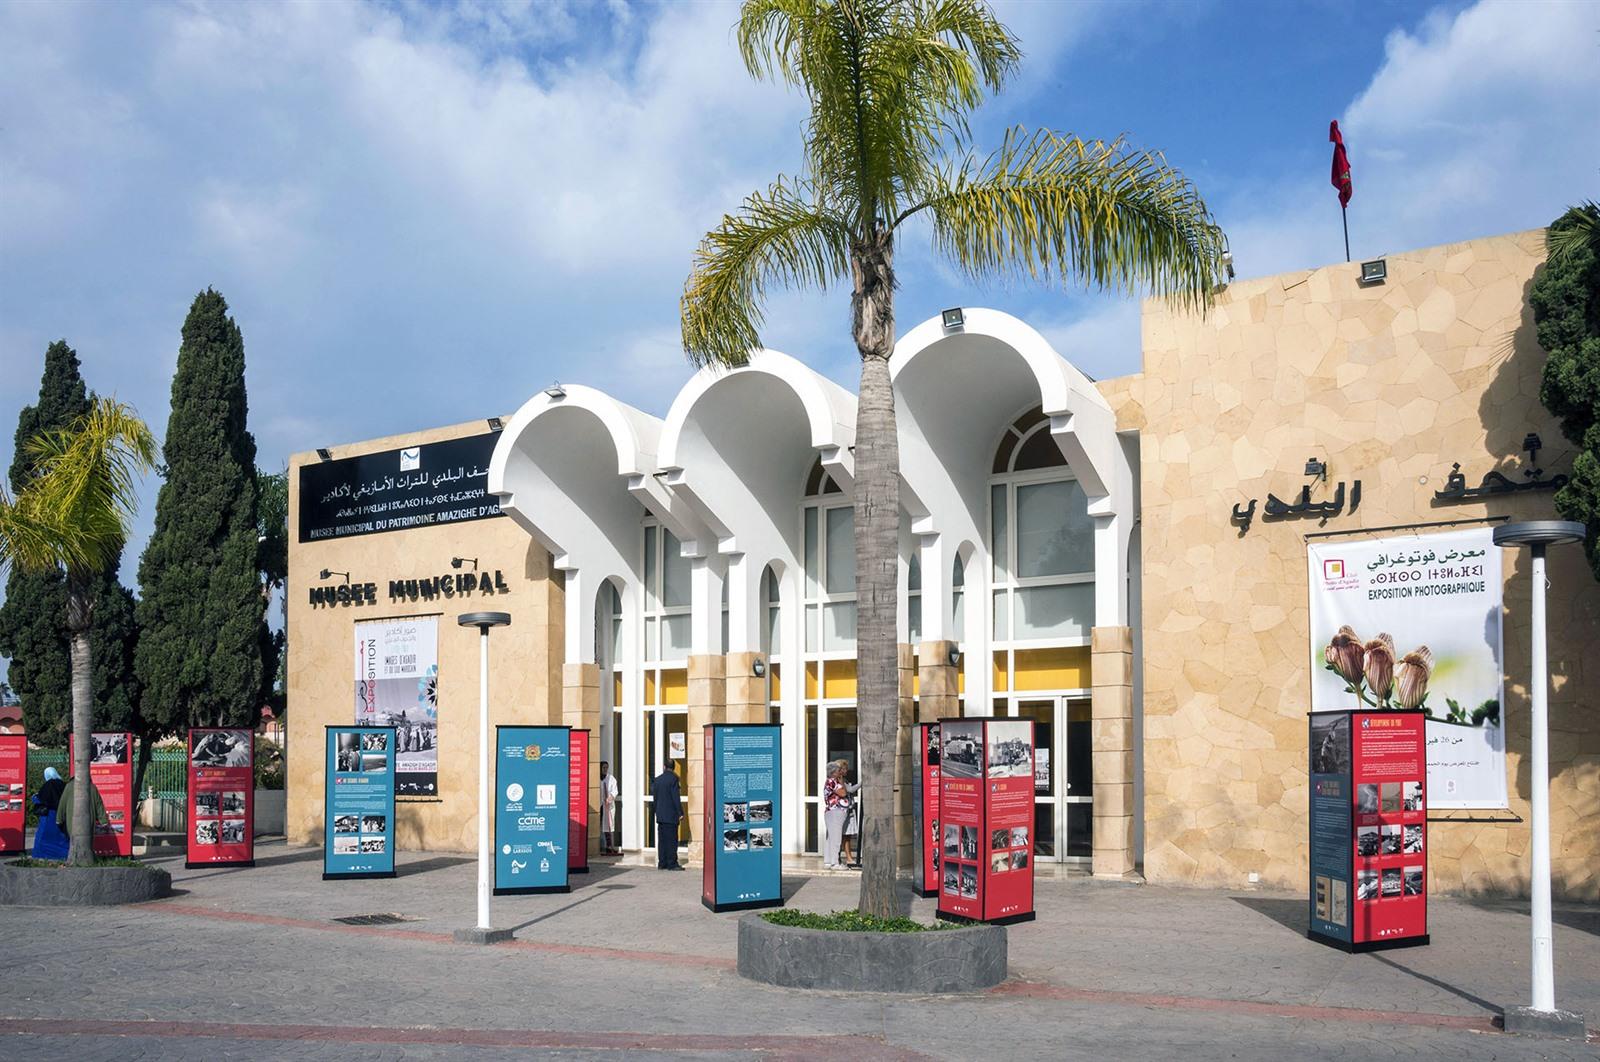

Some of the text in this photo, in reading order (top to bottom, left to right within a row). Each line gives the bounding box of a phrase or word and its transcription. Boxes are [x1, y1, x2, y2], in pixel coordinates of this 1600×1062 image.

[352, 475, 395, 501] الأمازيغي
[396, 472, 429, 490] للتراث
[432, 466, 464, 489] البلدي
[1232, 480, 1361, 533] البلدي
[310, 526, 335, 539] MUSEE
[335, 522, 374, 536] MUNICIPAL
[375, 519, 387, 530] DU
[388, 513, 435, 528] PATRIMOINE
[436, 507, 477, 522] AMAZIGHE
[1366, 549, 1486, 572] معرض فوتوغرافي
[309, 570, 508, 605] MUSEE MUNICIPAL
[1368, 581, 1485, 601] EXPOSITION PHOTOGRAPHIQUE
[367, 639, 376, 713] EXPOSITION
[518, 816, 546, 825] ccme
